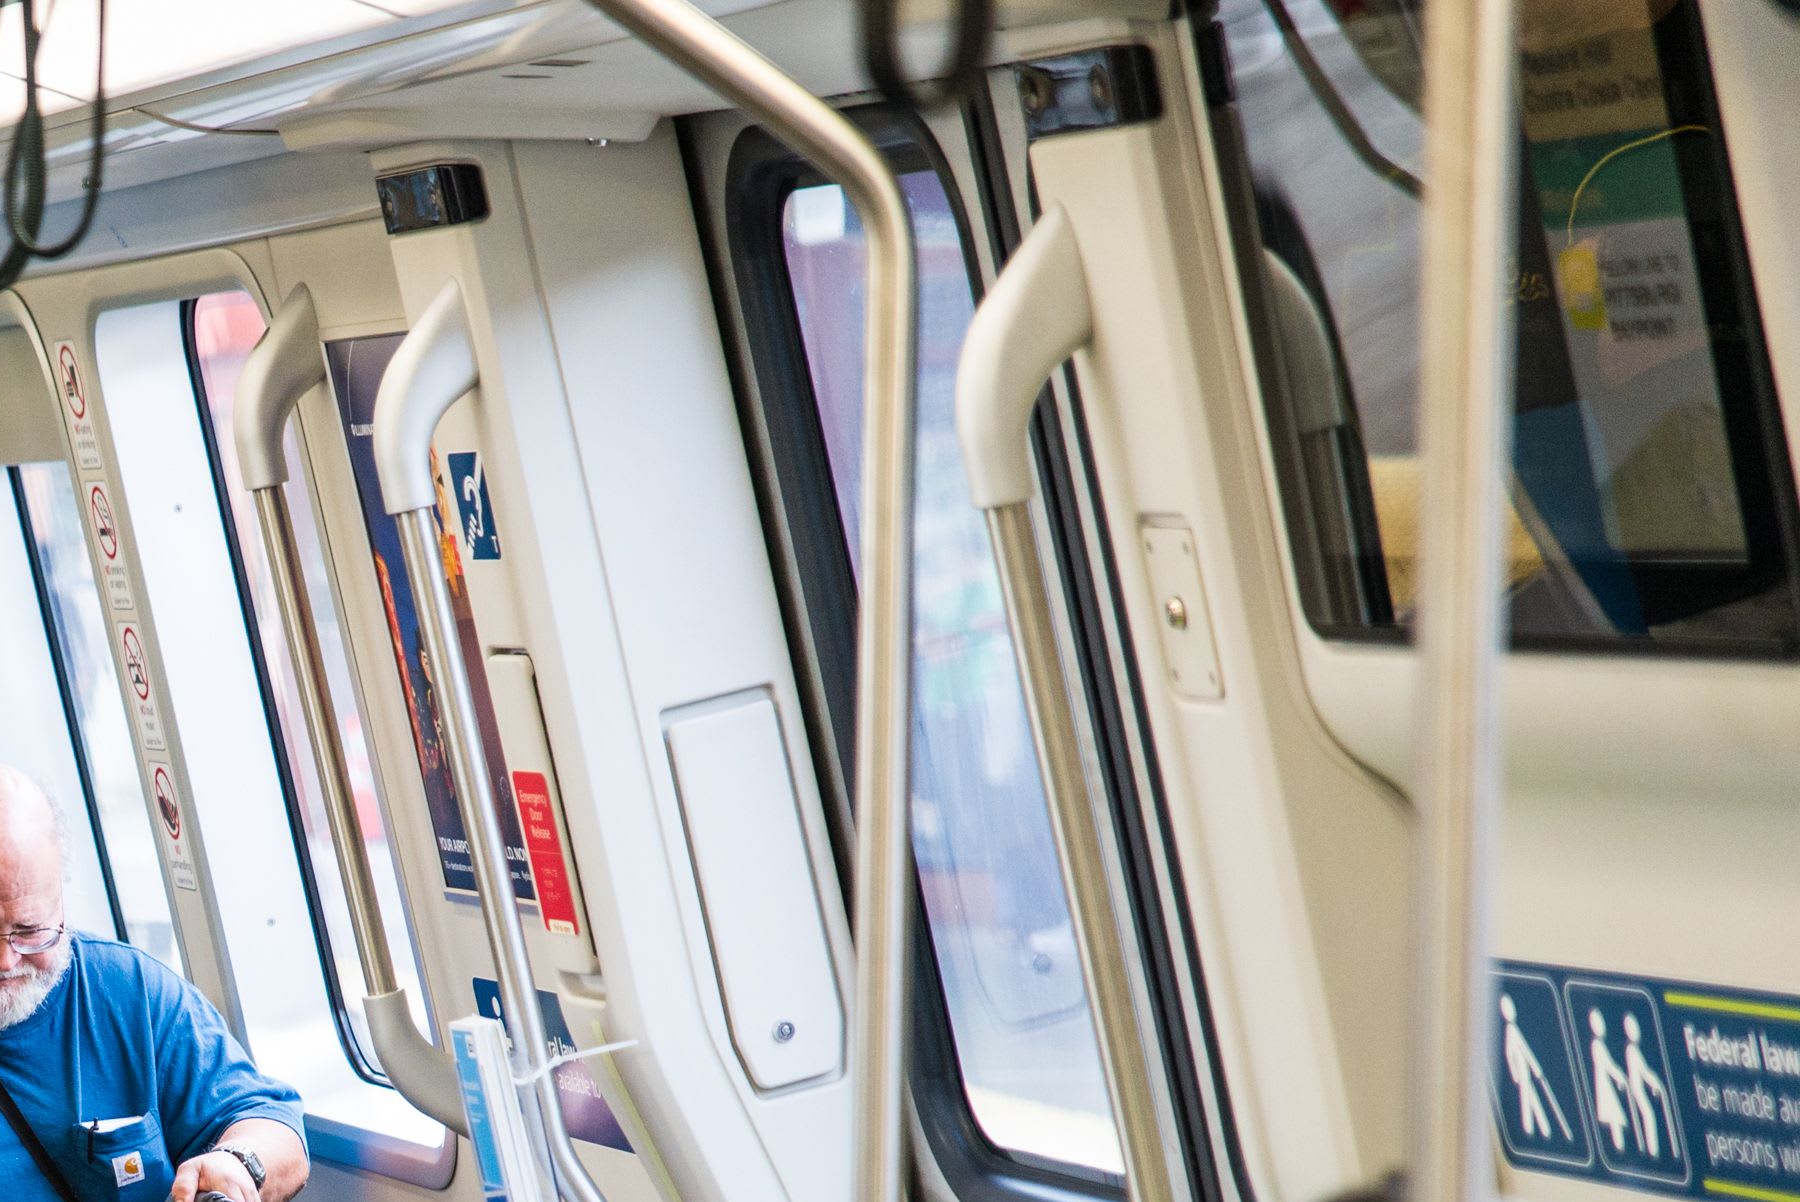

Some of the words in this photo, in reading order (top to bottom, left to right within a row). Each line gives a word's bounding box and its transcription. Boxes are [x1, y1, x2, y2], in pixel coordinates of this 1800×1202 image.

[519, 790, 548, 808] Emergency
[529, 808, 544, 822] Door
[531, 825, 551, 840] Release
[1684, 1022, 1760, 1071] Federal
[1693, 1073, 1720, 1112] be
[1722, 1082, 1776, 1121] made
[1705, 1131, 1778, 1169] persons
